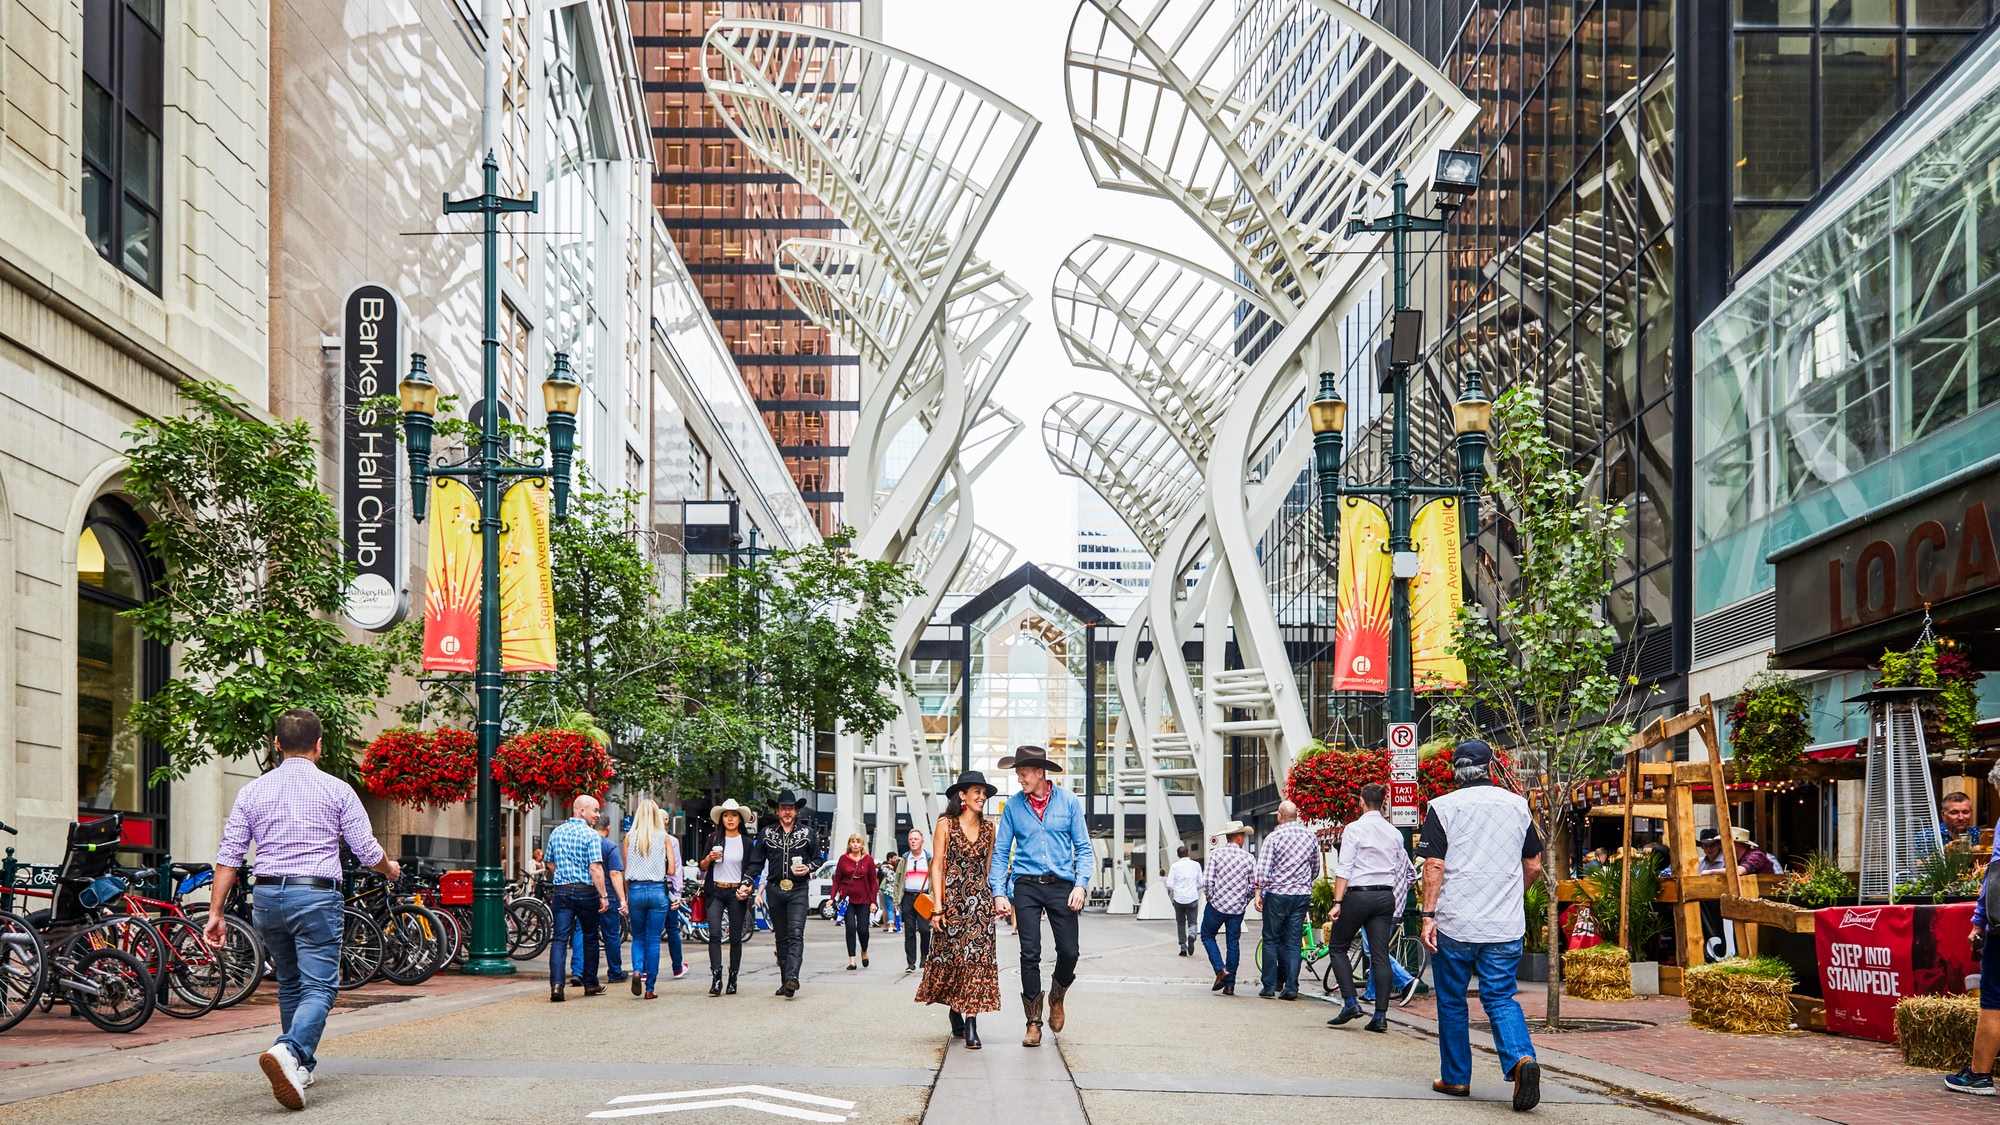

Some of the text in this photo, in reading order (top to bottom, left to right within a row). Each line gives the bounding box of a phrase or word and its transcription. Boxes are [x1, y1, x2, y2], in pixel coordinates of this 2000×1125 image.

[357, 298, 384, 567] Bankers Hall Club
[536, 518, 547, 570] Avenue
[1447, 539, 1457, 589] Avenue
[1829, 501, 2000, 635] LOCA
[537, 573, 552, 630] Stephen
[454, 657, 474, 665] calgary
[1365, 677, 1385, 685] calgary
[1394, 786, 1412, 794] TAXI
[1394, 795, 1414, 803] ONLY
[1843, 913, 1876, 924] Budweiser
[1831, 942, 1891, 968] STEP INTO
[1827, 966, 1901, 997] STAMPEDE
